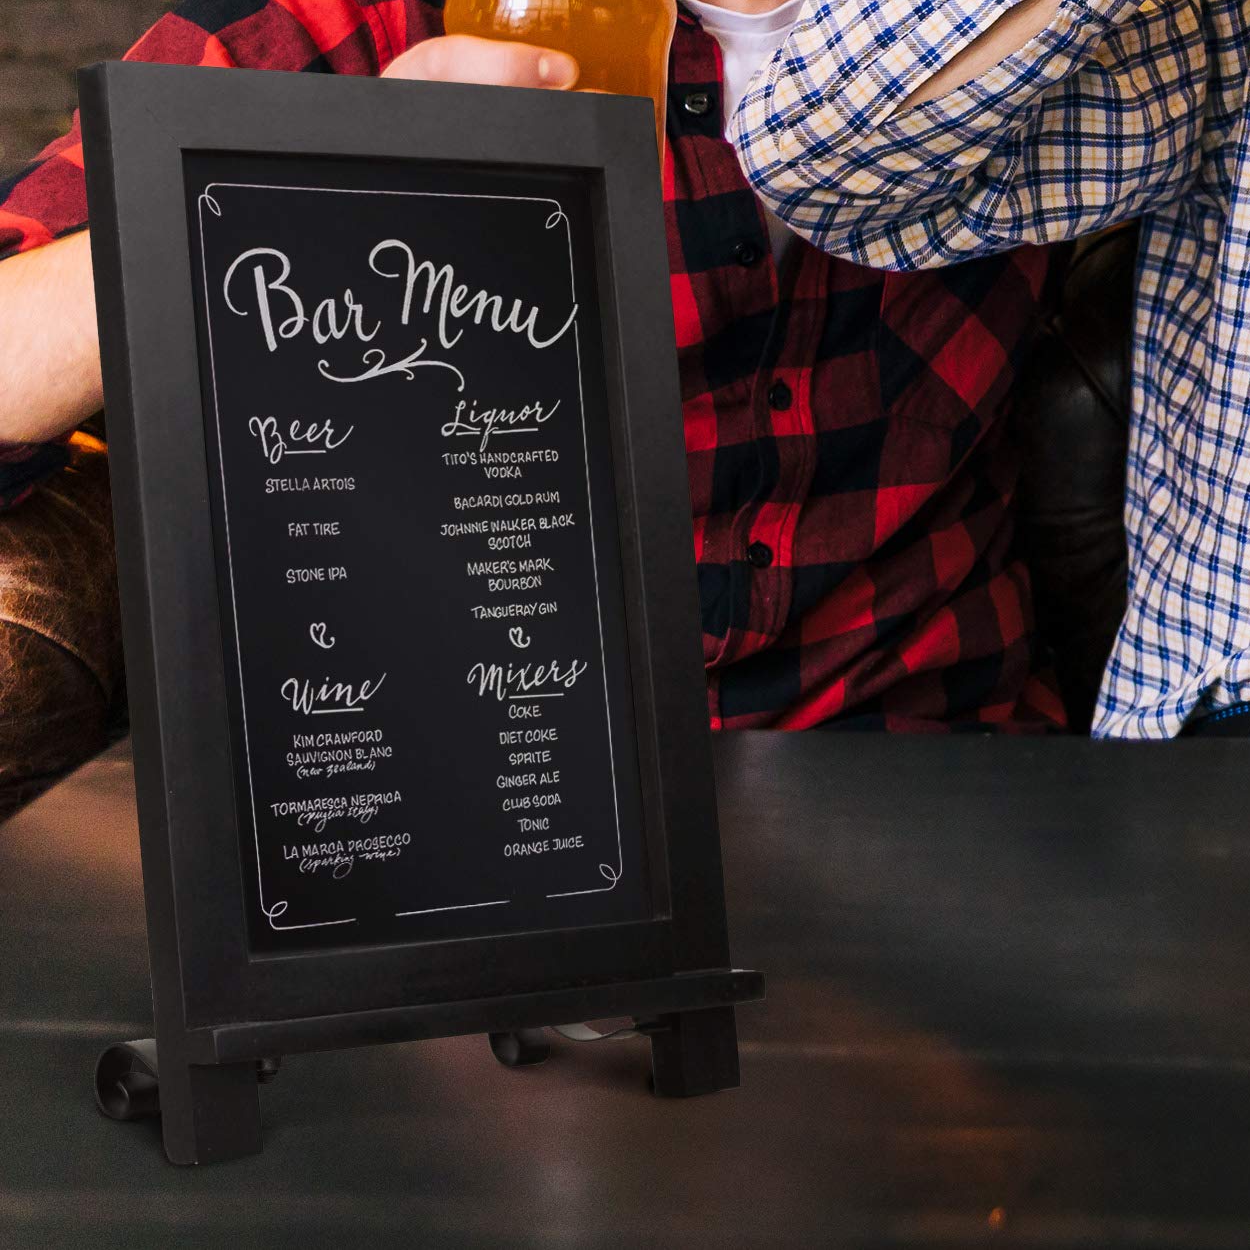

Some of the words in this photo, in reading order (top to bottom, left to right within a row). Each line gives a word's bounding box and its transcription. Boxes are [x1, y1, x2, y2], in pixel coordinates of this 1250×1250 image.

[223, 247, 381, 352] Bar
[368, 239, 578, 349] Menu
[441, 399, 561, 452] Liquor
[248, 416, 354, 464] Beer
[441, 452, 477, 465] TITO'S
[480, 449, 559, 464] HANDCRAFTED
[484, 466, 522, 479] VODKA
[265, 477, 310, 493] STELLA
[313, 477, 356, 491] ARTOIS
[454, 494, 503, 510] BACARDI
[504, 493, 534, 506] GOLD
[536, 491, 560, 503] RUM
[288, 522, 310, 536] FAT
[313, 521, 340, 535] TIRE
[440, 520, 489, 536] JOHNNIE
[490, 518, 537, 532] WALKER
[539, 513, 575, 529] BLACK
[488, 533, 532, 550] SCOTCH
[286, 567, 325, 583] STONE
[328, 566, 348, 580] IPA
[466, 559, 517, 576] MAKER'S
[519, 557, 555, 572] MARK
[488, 575, 542, 591] BOURBON
[538, 601, 558, 615] GIN
[467, 659, 588, 700] Mixers
[281, 673, 387, 715] Wine
[508, 704, 542, 719] COKE
[293, 734, 315, 749] KIM
[315, 729, 383, 747] CRAWFORD
[499, 730, 523, 745] DIET
[525, 728, 558, 743] COKE
[286, 749, 353, 767] SAUVIGNON
[355, 746, 393, 760] BLANC
[508, 750, 552, 766] SPRITE
[496, 773, 537, 789] GINGER
[539, 770, 561, 785] ALE
[270, 797, 348, 817] TORMARESCA
[350, 791, 402, 807] NEPRICA
[502, 796, 532, 812] CLUB
[532, 793, 562, 808] SODA
[517, 817, 550, 833] TONIC
[283, 844, 299, 860] LA
[301, 840, 345, 858] MARCA
[347, 832, 412, 853] PROSECCO
[504, 840, 550, 857] ORANGE
[552, 835, 585, 851] JUICE
